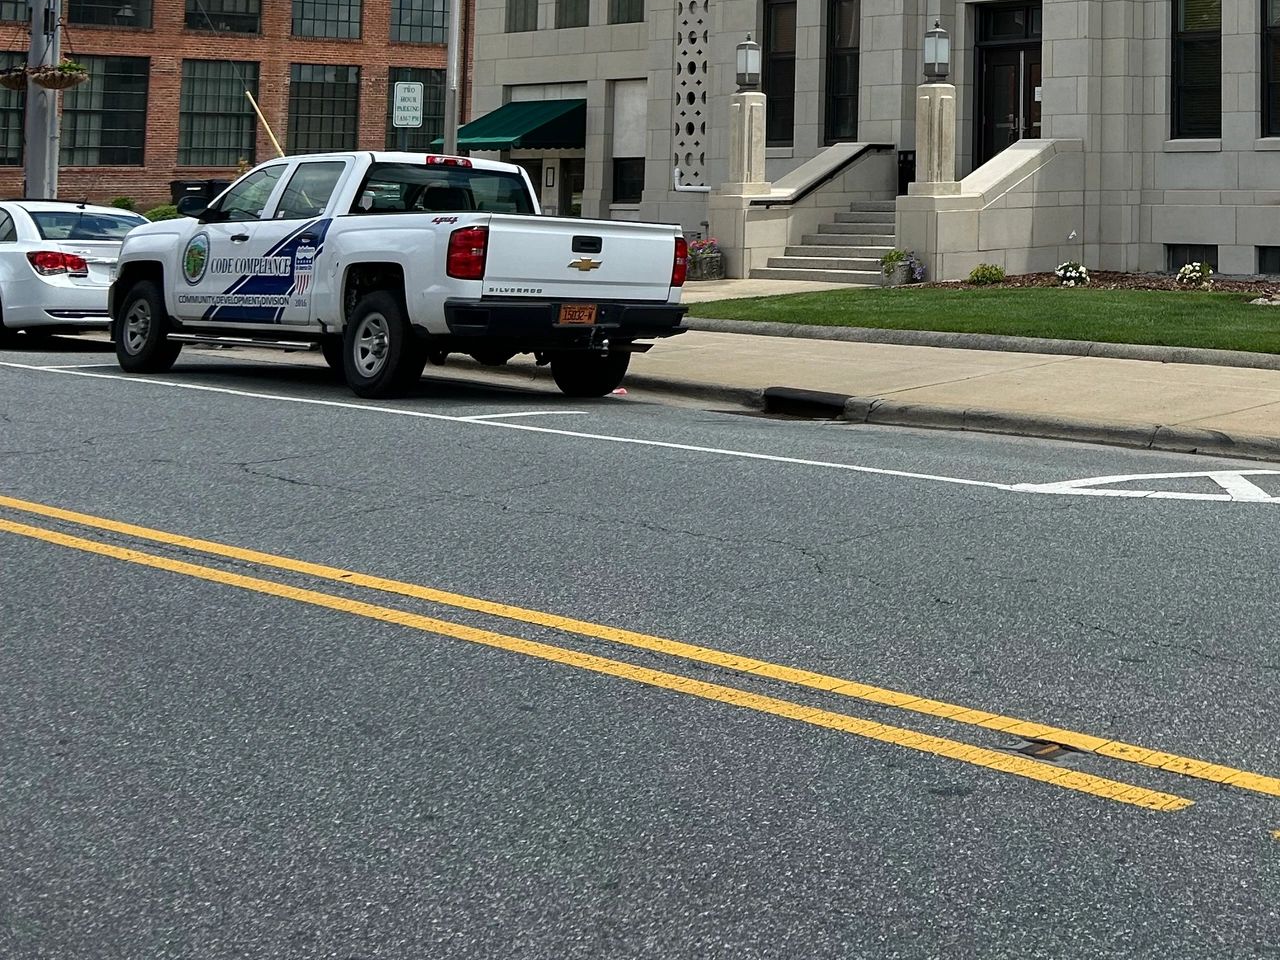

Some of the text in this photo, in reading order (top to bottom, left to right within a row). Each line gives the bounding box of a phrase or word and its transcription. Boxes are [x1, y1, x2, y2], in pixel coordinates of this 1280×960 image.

[211, 257, 290, 276] CODE COMPLIANCE
[178, 295, 290, 305] COMMUNITY DEVELOPMENT DIVISION
